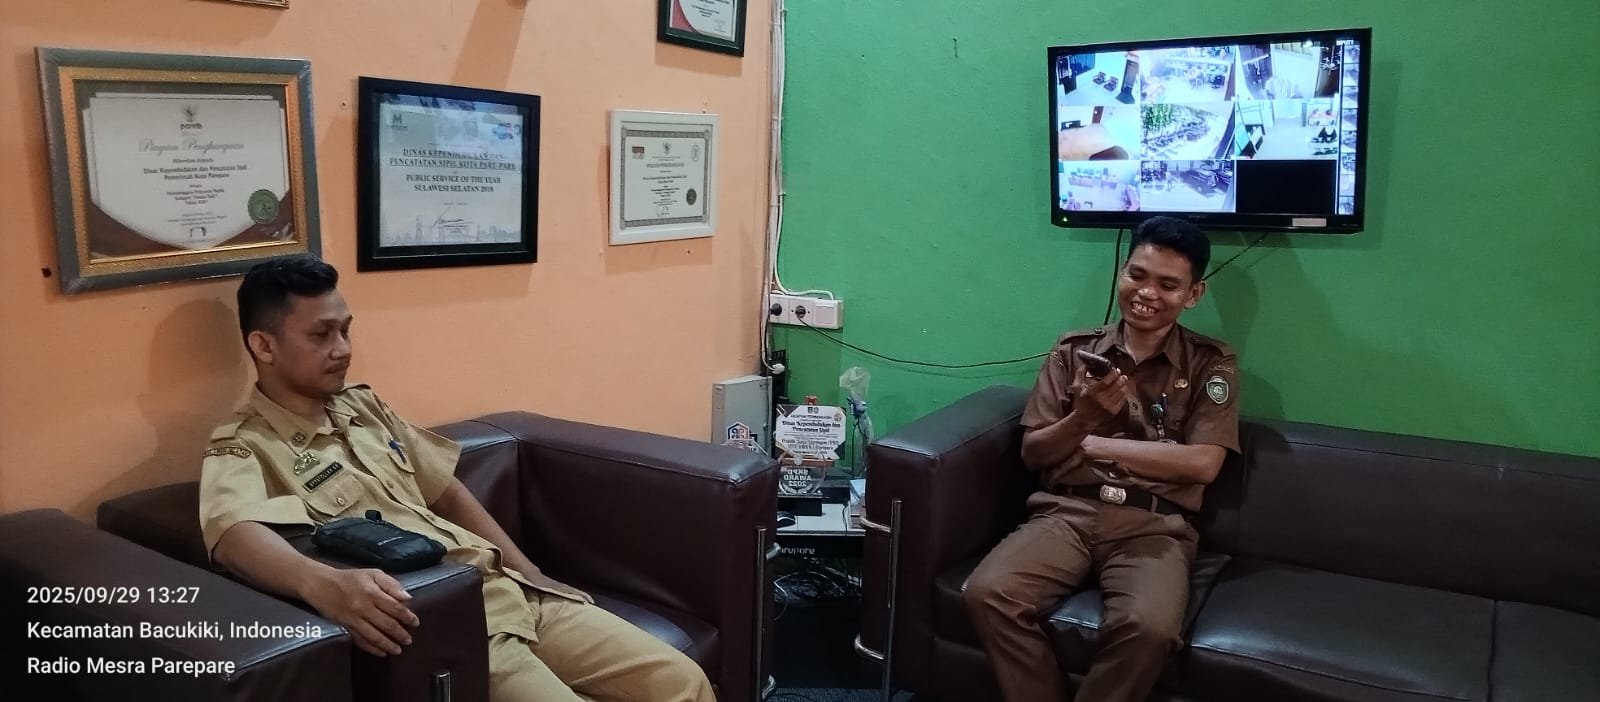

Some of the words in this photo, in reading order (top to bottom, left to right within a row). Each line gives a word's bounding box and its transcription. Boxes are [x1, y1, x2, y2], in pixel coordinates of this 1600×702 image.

[403, 148, 427, 158] DINAS
[405, 174, 430, 182] PUBLIC
[431, 174, 459, 183] SERVICE
[459, 175, 470, 183] OF
[470, 175, 485, 183] THE
[484, 176, 502, 184] YEAR
[413, 184, 450, 192] SULAWESI
[449, 184, 481, 192] SELATAN
